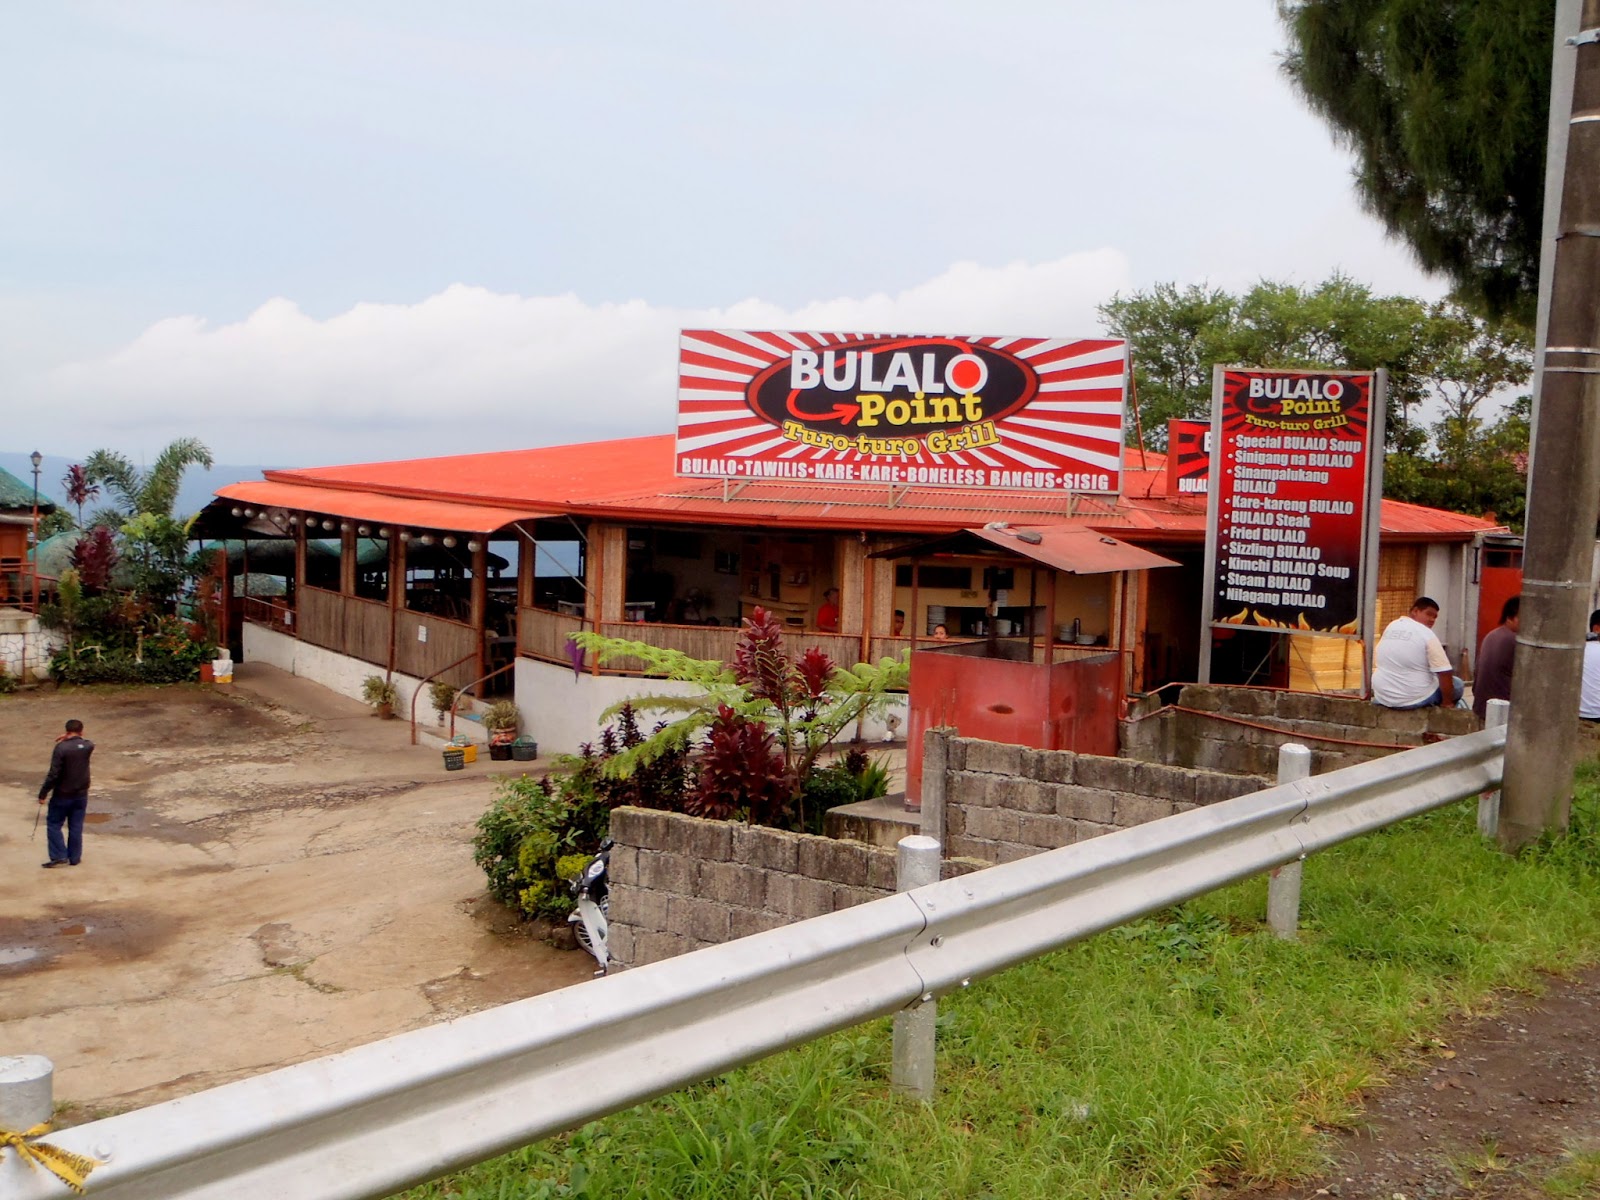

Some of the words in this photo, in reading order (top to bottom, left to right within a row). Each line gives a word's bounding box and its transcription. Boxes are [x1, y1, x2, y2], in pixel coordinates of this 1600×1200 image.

[790, 349, 989, 395] BULALO
[1249, 378, 1344, 400] BULALO
[855, 391, 983, 427] Point
[1280, 397, 1341, 415] Point
[1245, 413, 1310, 431] Turo-turo
[1313, 414, 1349, 430] Grill
[782, 418, 921, 456] Turo-turo
[926, 419, 1001, 454] Grill
[1235, 434, 1282, 449] Special
[1283, 436, 1328, 451] BULALO
[1329, 438, 1362, 453] Soup
[1235, 450, 1289, 466] Sinigang
[1290, 454, 1307, 466] na
[1308, 453, 1354, 468] BULALO
[681, 457, 737, 476] BULALO
[744, 459, 808, 479] TAWILIS
[814, 462, 899, 483] KARE-KARE
[907, 465, 985, 486] BONELESS
[990, 468, 1055, 489] BANGUS
[1063, 472, 1109, 491] SISIG
[1234, 465, 1329, 484] Sinampalukang
[1178, 478, 1208, 492] BULAL
[1233, 480, 1277, 494] BULALO
[1232, 495, 1308, 514] Kare-kareng
[1309, 499, 1354, 515] BULALO
[1231, 510, 1275, 526] BULALO
[1276, 513, 1311, 528] Steak
[1230, 526, 1261, 540] Fried
[1262, 528, 1306, 543] BULALO
[1229, 541, 1275, 558] Sizzling
[1276, 545, 1321, 560] BULALO
[1228, 557, 1271, 573] Kimchi
[1272, 560, 1316, 576] BULALO
[1318, 563, 1350, 579] Soup
[1227, 572, 1266, 588] Steam
[1267, 575, 1312, 591] BULALO
[1226, 588, 1280, 606] Nilagang
[1281, 592, 1326, 608] BULALO
